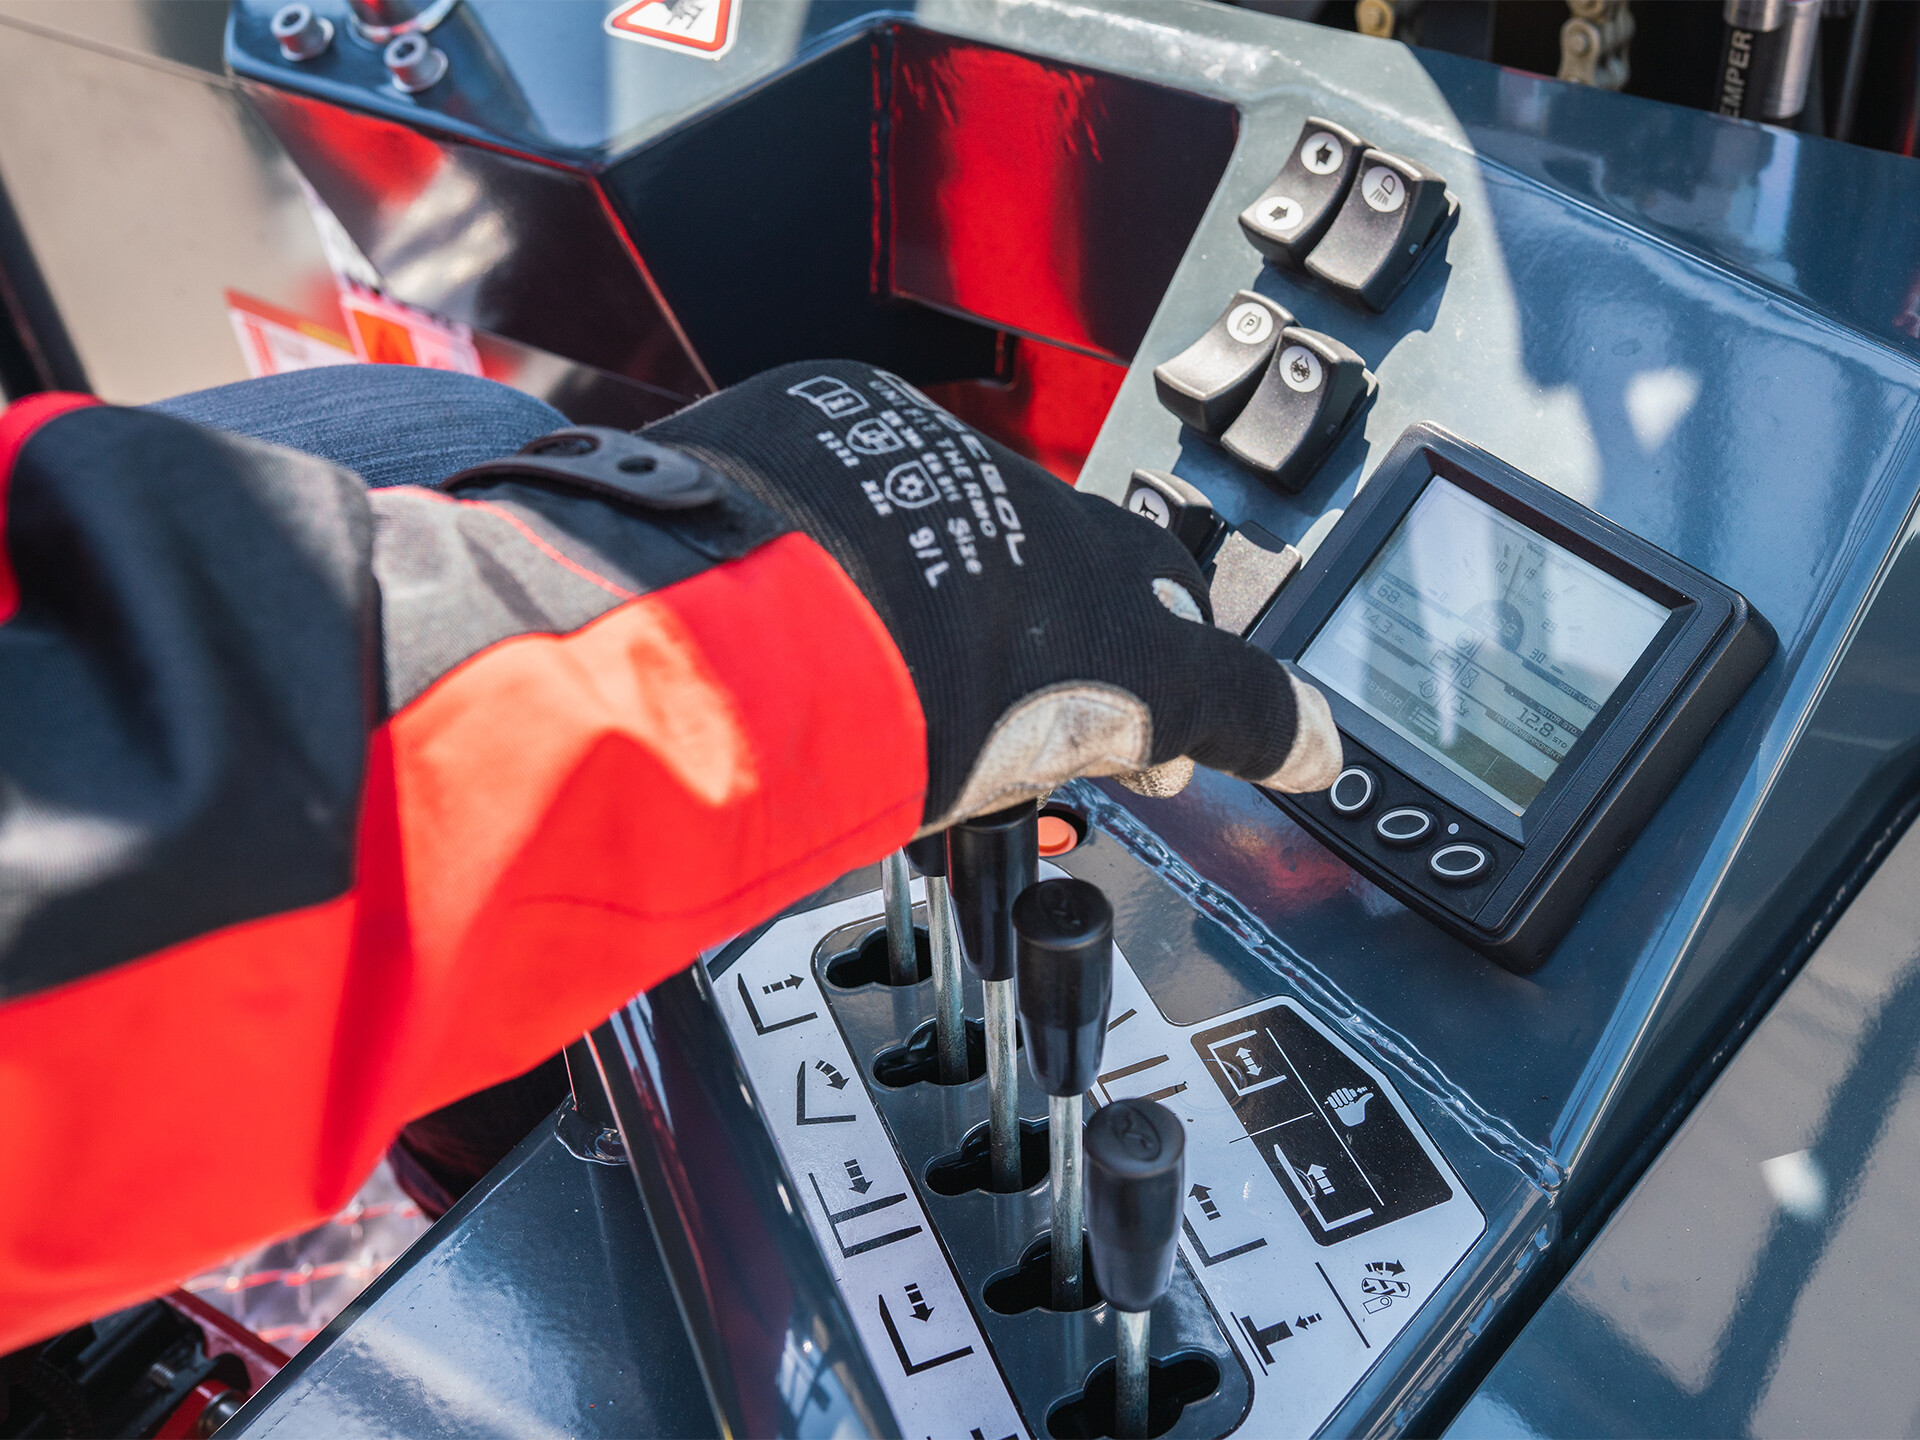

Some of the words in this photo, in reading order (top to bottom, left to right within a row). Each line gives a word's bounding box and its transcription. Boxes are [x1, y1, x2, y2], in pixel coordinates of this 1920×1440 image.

[936, 437, 997, 538] THERMO
[909, 526, 949, 588] 9/L
[948, 517, 982, 575] Size
[1493, 560, 1508, 573] 10
[1523, 566, 1537, 579] 15
[1377, 584, 1400, 604] 68
[1528, 647, 1547, 663] 30
[1556, 681, 1576, 696] SOOT
[1516, 707, 1555, 738] 12.8
[1550, 735, 1568, 749] STD
[1536, 705, 1562, 724] MOTOR
[1561, 721, 1578, 734] STD
